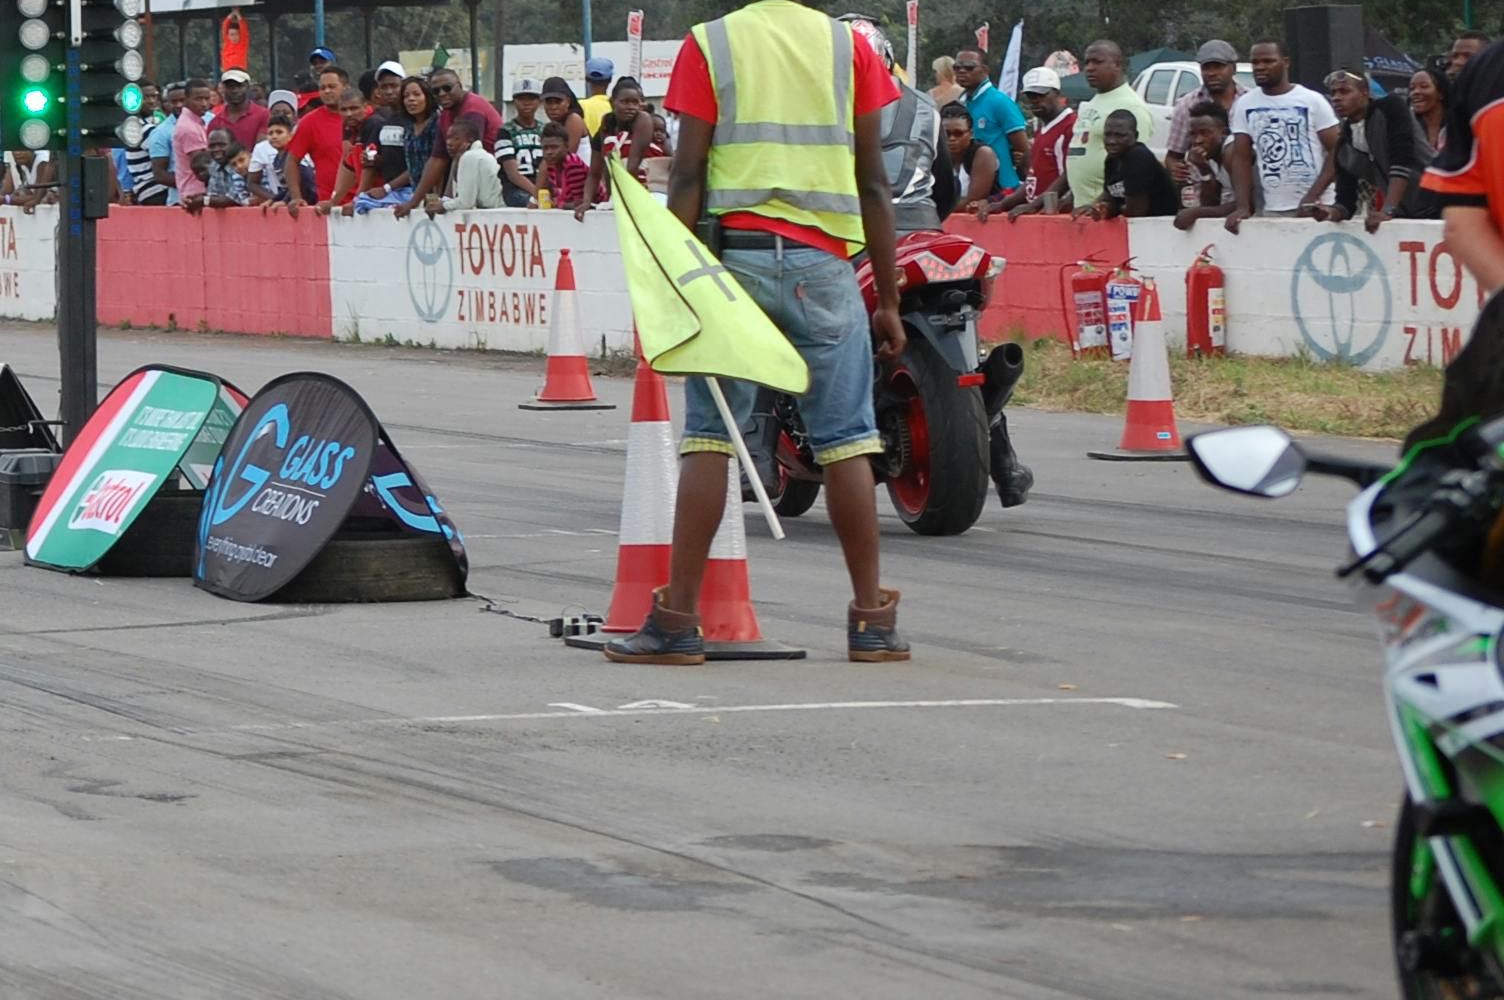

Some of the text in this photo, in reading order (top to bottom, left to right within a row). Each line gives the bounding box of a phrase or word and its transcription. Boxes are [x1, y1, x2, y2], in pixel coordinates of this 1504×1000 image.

[455, 223, 547, 278] TOYOTA
[457, 290, 548, 326] ZIMBABWE
[279, 435, 355, 490] GLASS
[251, 488, 319, 525] CREATIONS
